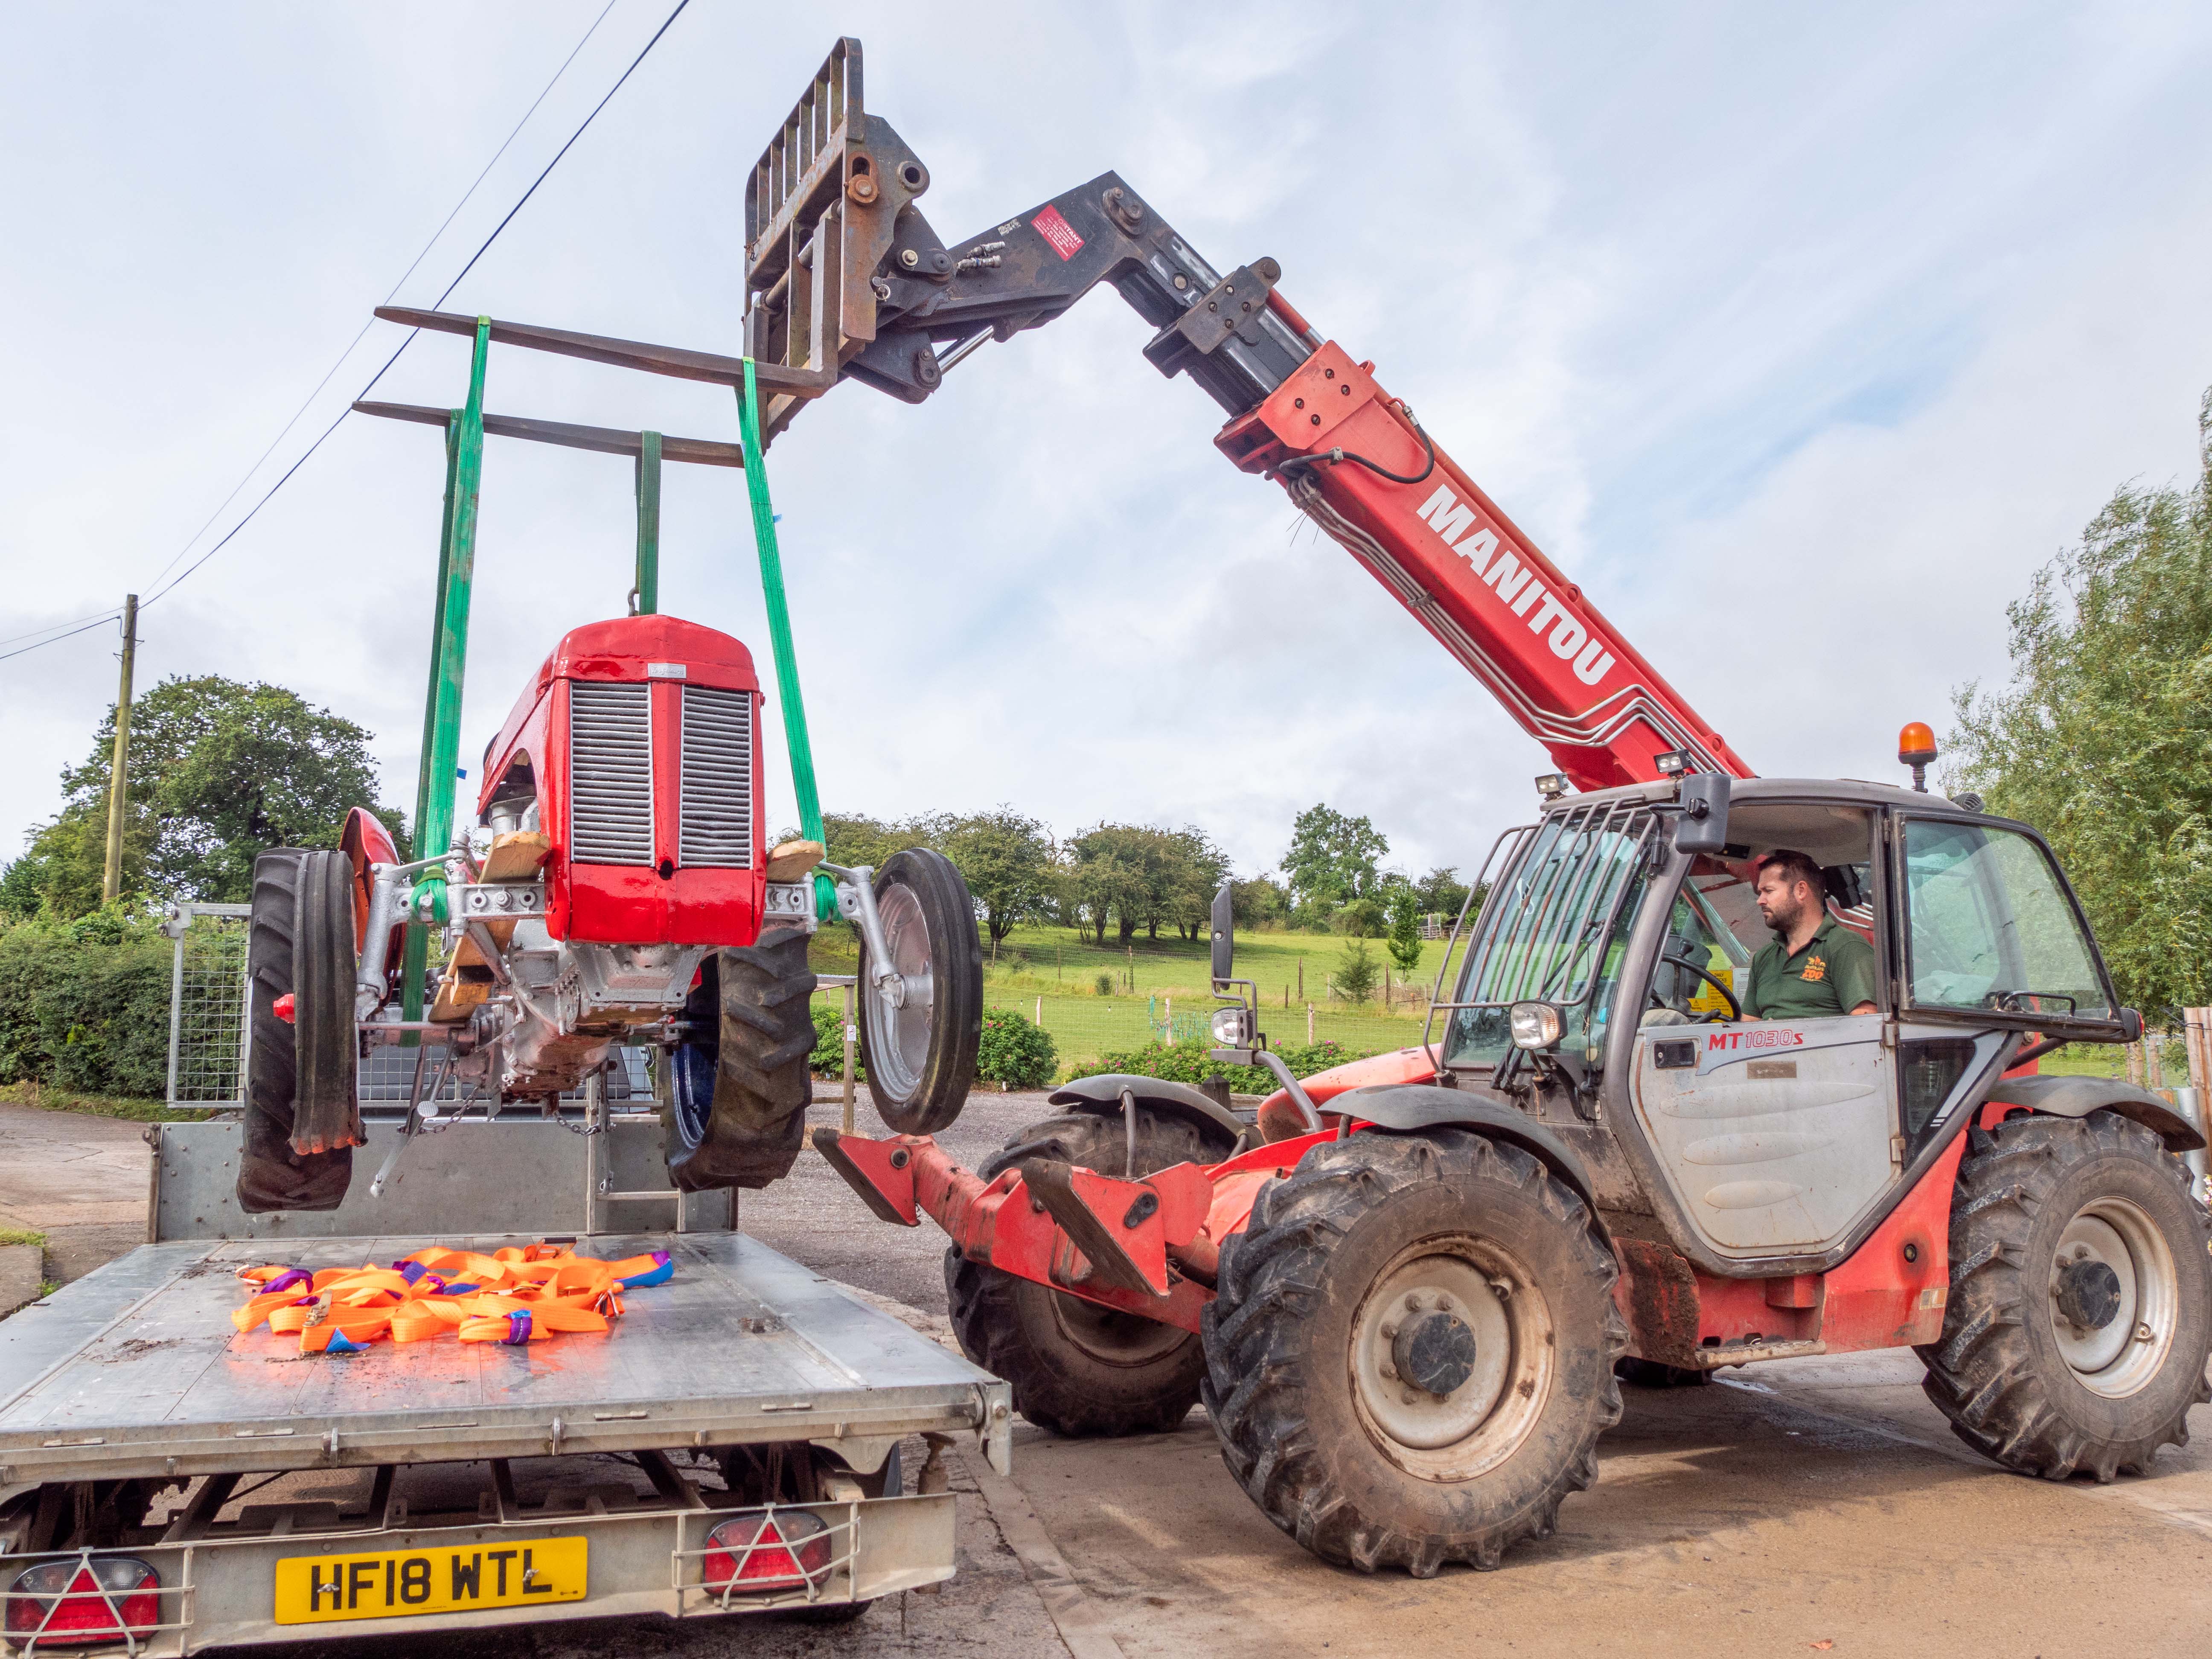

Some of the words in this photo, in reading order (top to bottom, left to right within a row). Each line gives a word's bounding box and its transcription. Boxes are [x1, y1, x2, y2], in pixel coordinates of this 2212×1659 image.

[1416, 483, 1616, 685] MANITOU
[1802, 969, 1824, 980] ZOO
[310, 1557, 431, 1612] HF18
[451, 1548, 552, 1601] WTL
